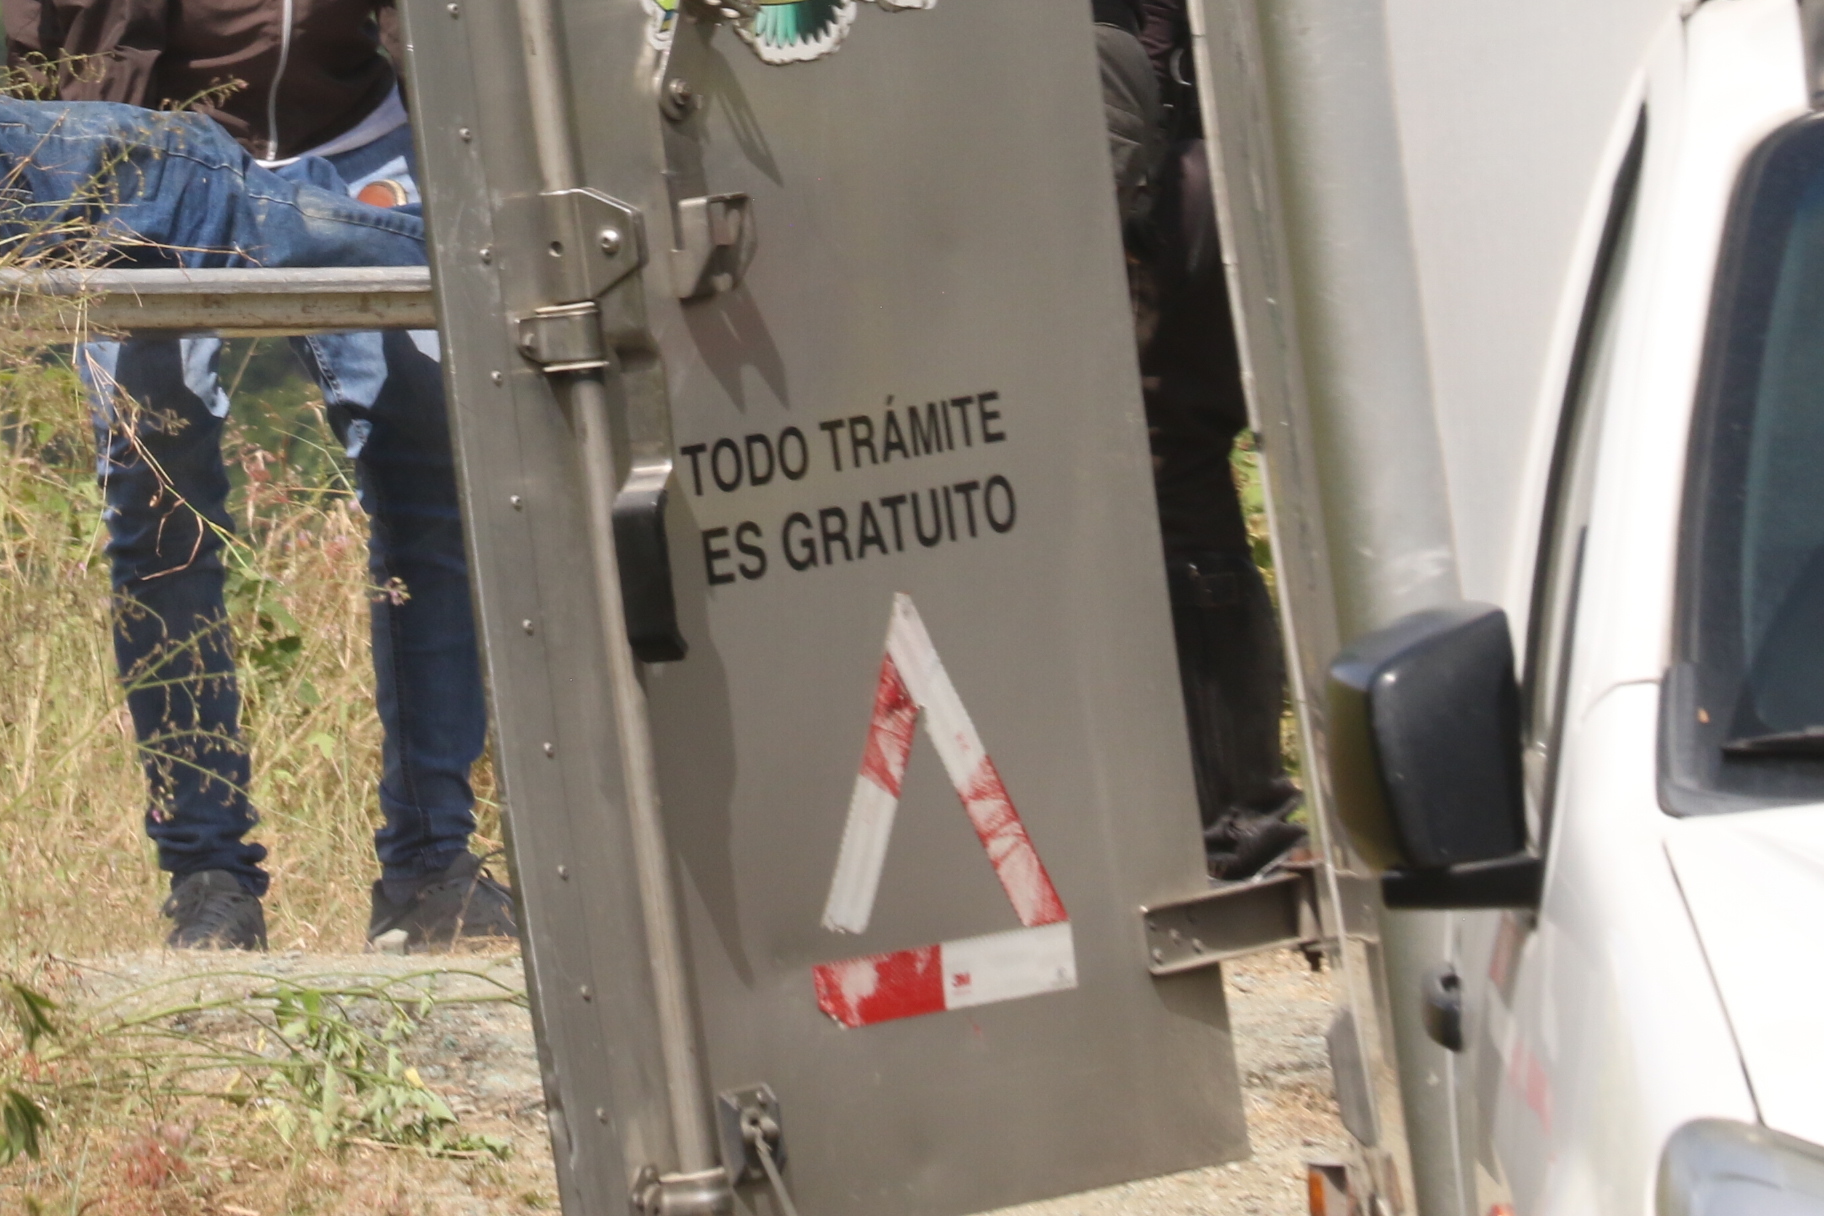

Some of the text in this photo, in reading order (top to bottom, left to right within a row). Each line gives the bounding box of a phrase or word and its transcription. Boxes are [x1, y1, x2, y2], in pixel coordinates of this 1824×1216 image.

[680, 391, 1007, 496] TODO TRÁMITE
[702, 474, 1017, 586] ES GRATUITO
